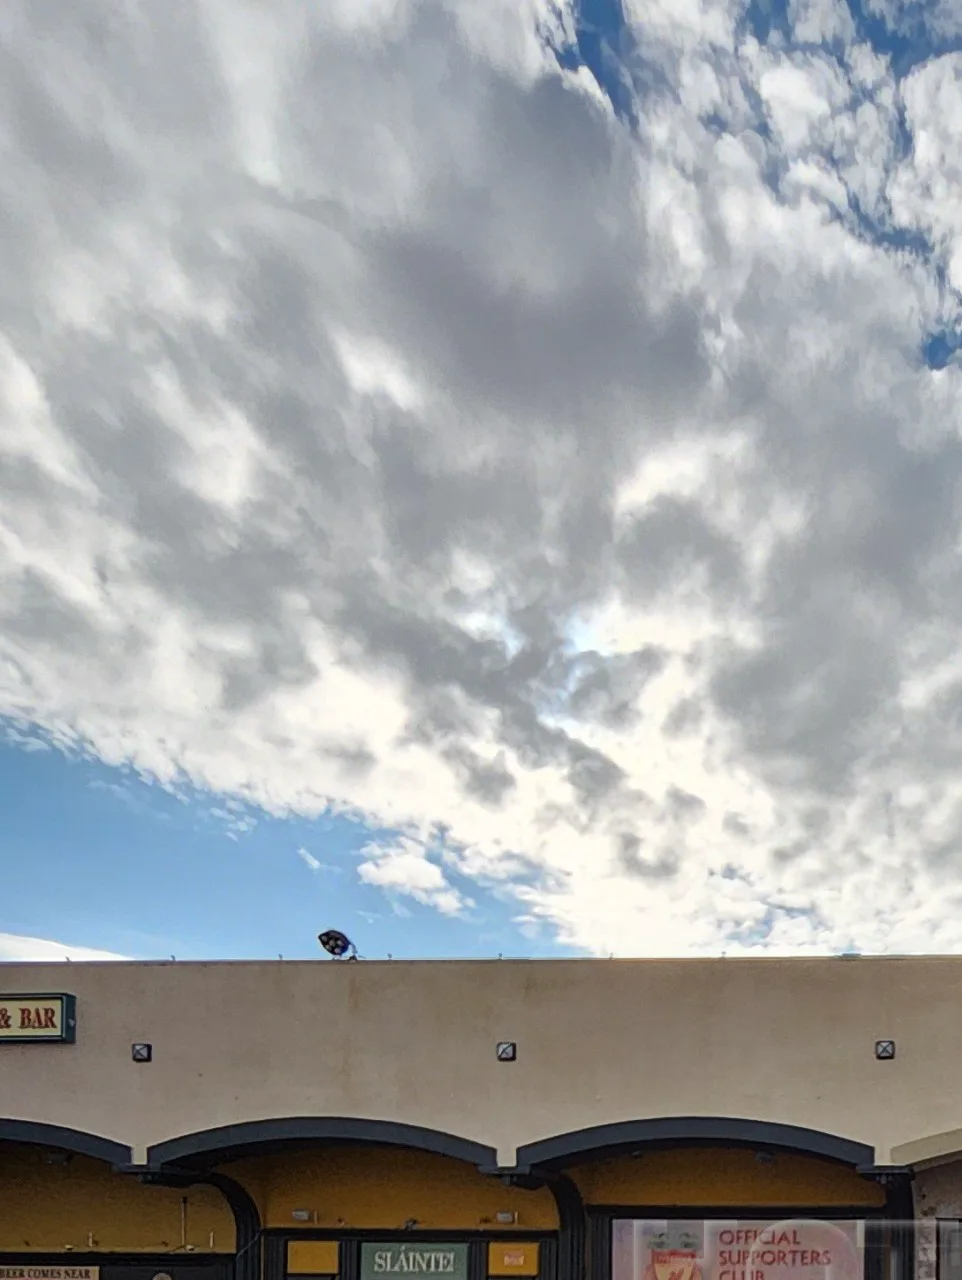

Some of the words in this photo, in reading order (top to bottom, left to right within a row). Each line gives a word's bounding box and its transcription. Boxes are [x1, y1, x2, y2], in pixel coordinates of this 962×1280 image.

[18, 1007, 57, 1029] BAR
[718, 1230, 801, 1246] OFFICIAL
[718, 1250, 832, 1267] SUPPORTERS
[28, 1268, 61, 1279] COMES
[64, 1268, 91, 1279] NEAR
